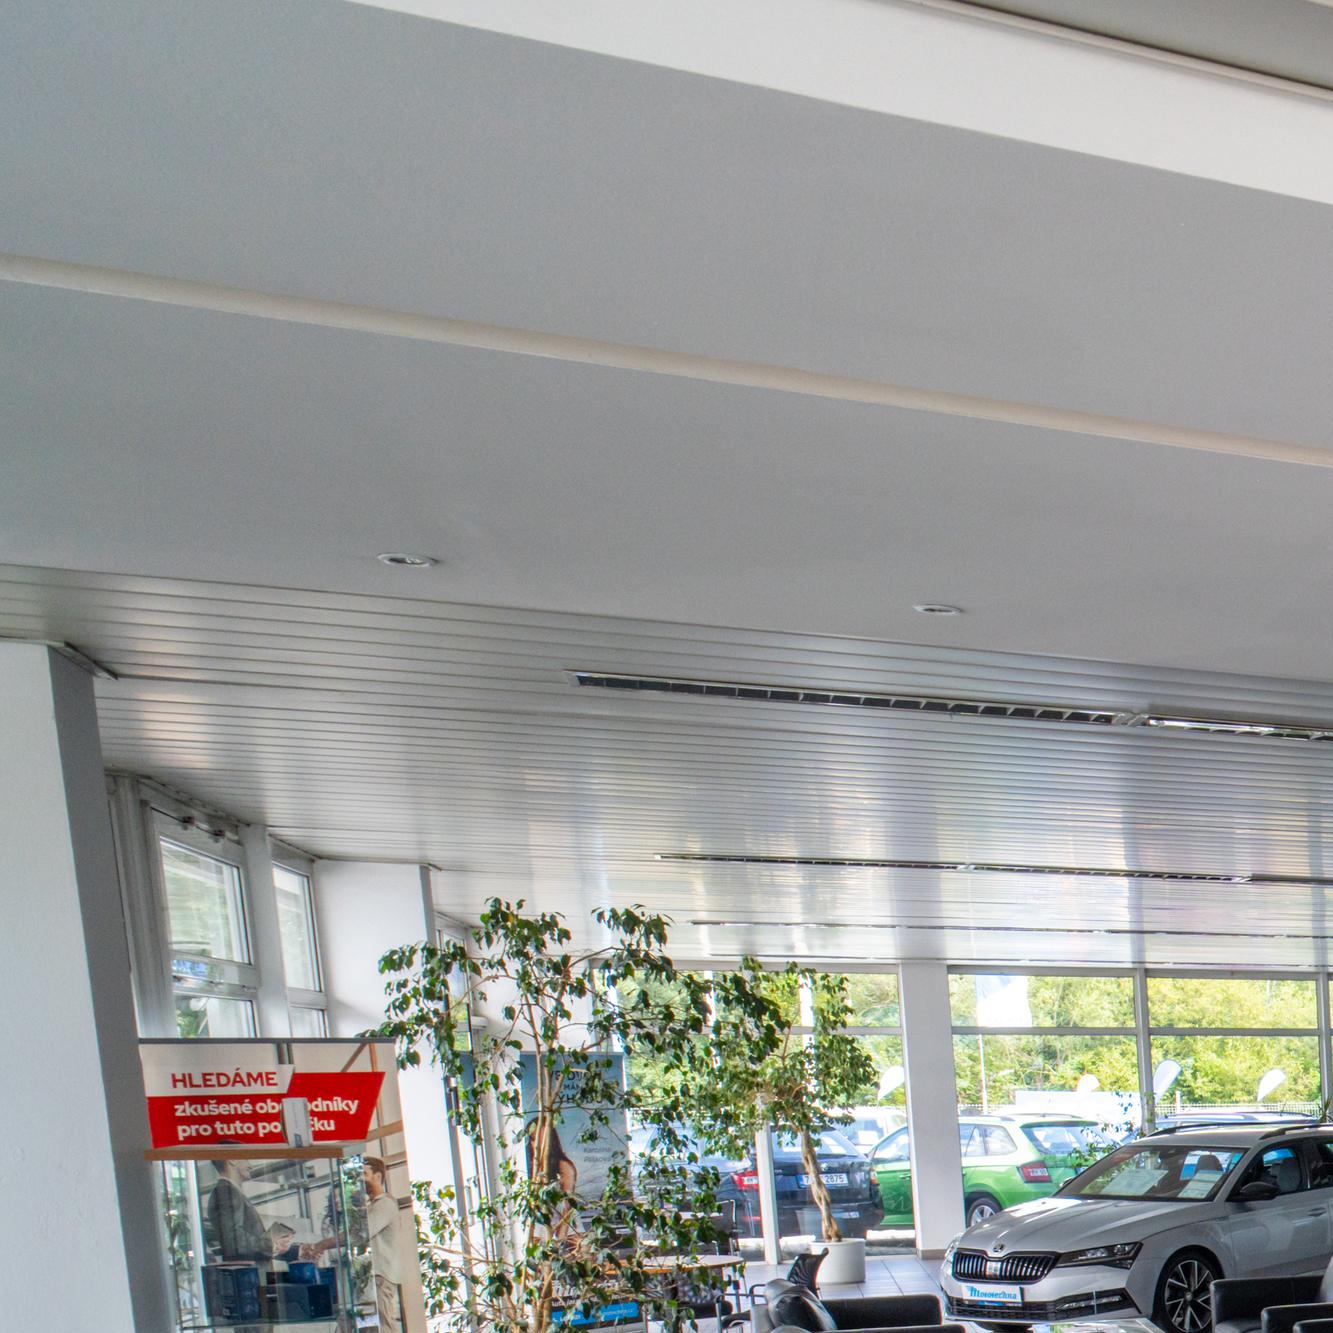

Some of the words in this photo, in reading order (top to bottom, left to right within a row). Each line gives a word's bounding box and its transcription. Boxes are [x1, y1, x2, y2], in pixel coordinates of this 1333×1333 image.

[171, 1067, 278, 1089] HLEDÁME
[174, 1099, 253, 1117] zkušené
[255, 1096, 359, 1114] obdníky
[177, 1124, 211, 1141] pro
[214, 1119, 252, 1136] tuto
[257, 1117, 336, 1137] poku
